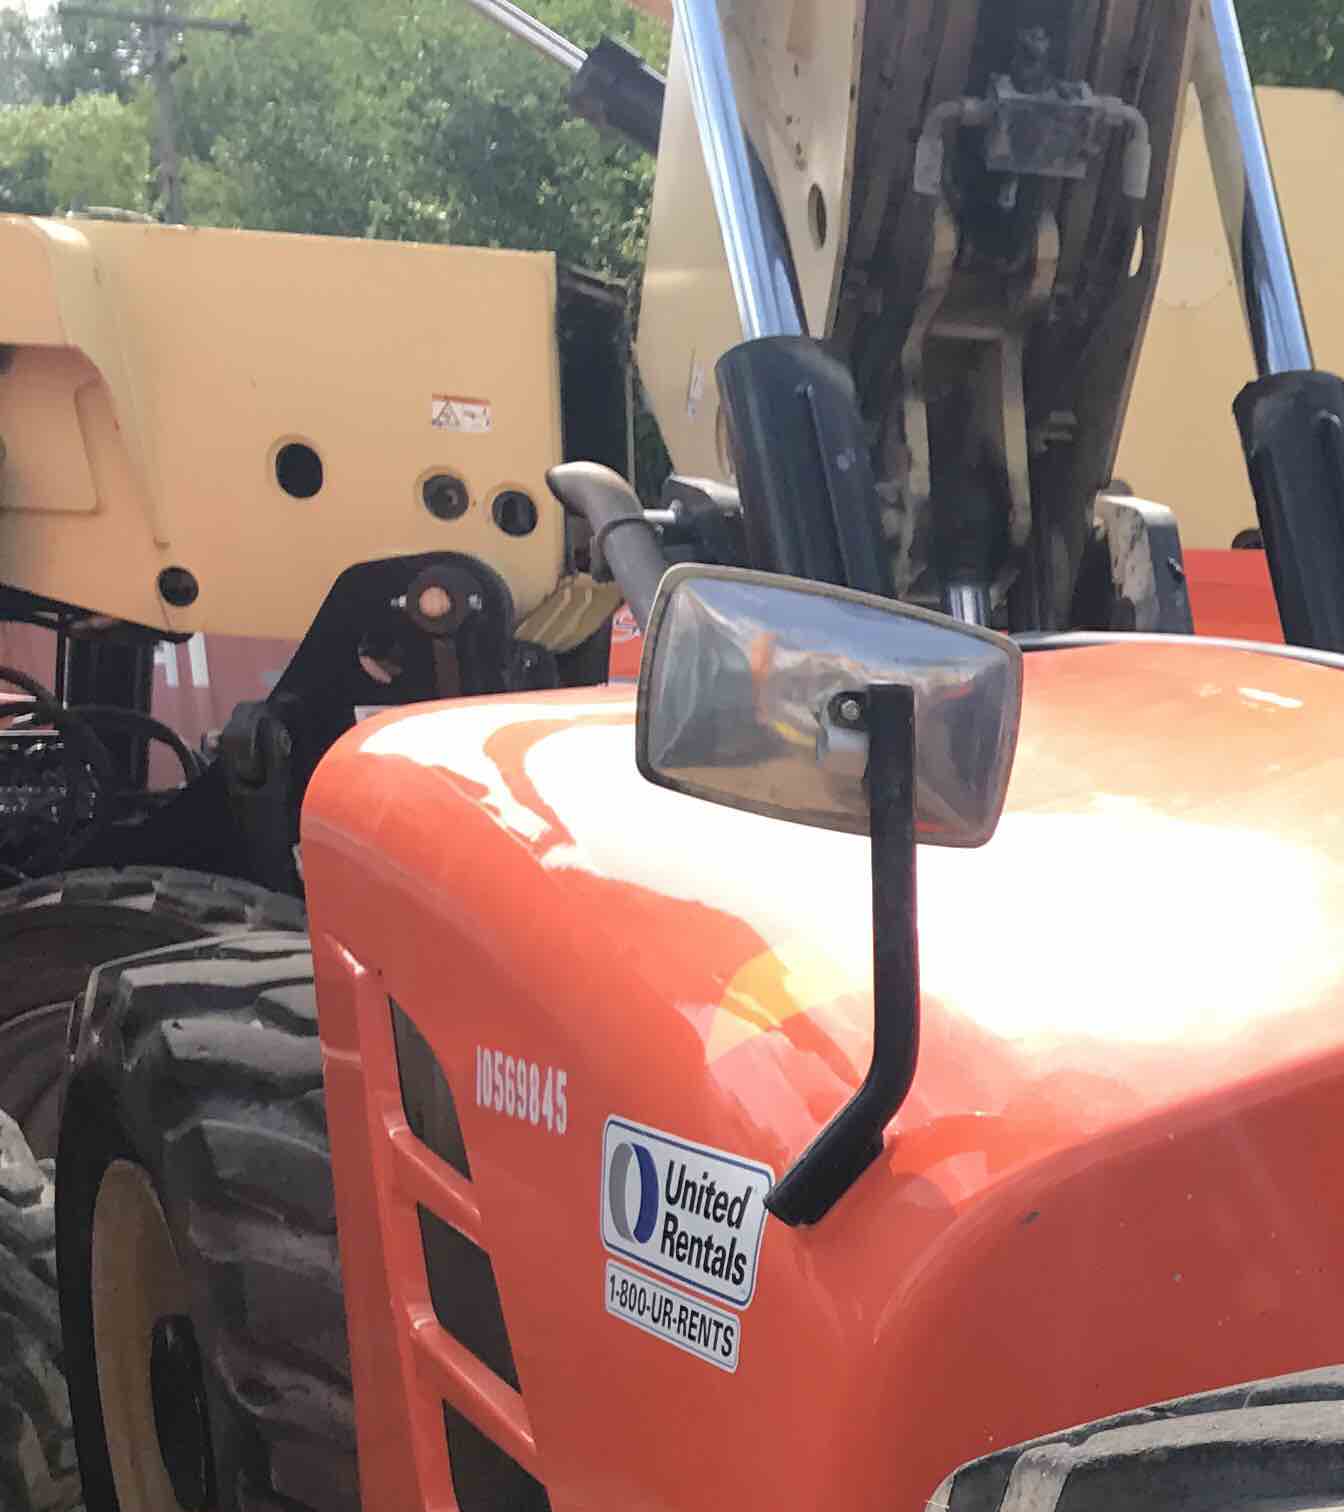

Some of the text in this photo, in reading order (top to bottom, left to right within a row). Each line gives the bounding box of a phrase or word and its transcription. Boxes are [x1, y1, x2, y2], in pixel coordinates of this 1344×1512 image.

[664, 1159, 754, 1230] United
[660, 1211, 747, 1287] Rentals
[608, 1274, 735, 1358] 1-800-UR-RENTS
